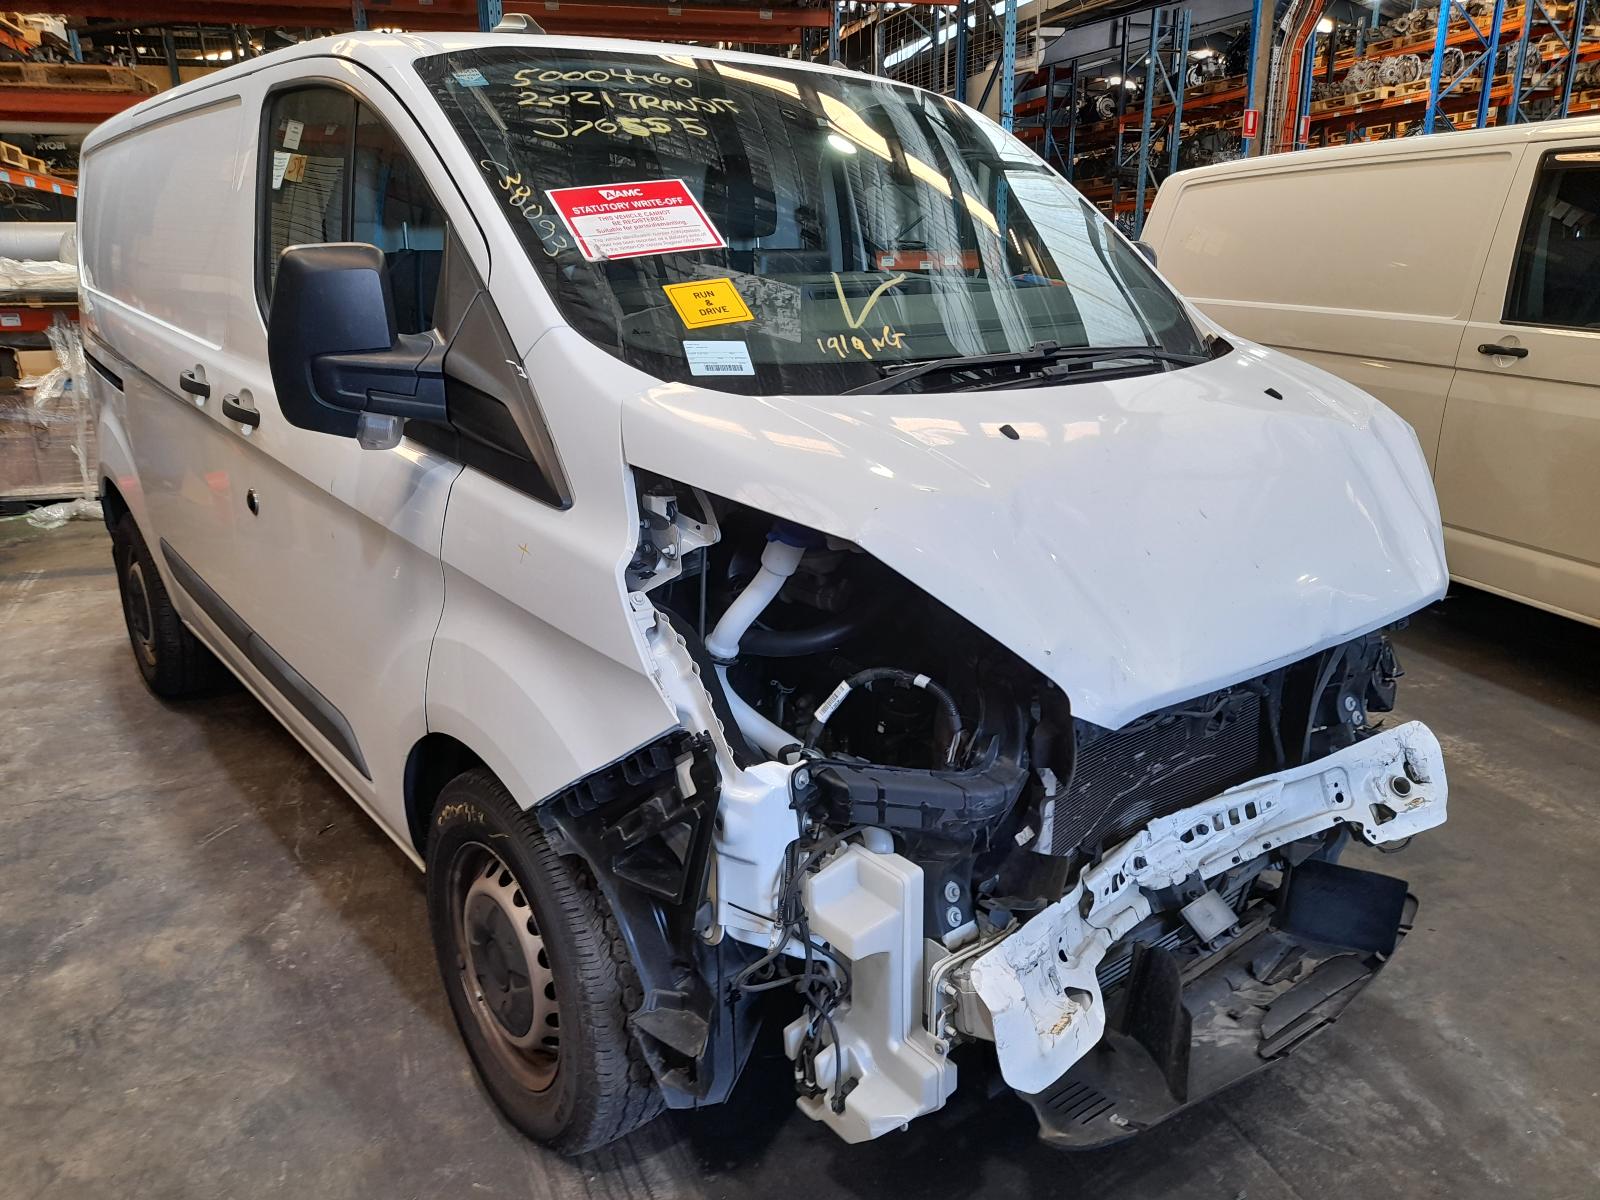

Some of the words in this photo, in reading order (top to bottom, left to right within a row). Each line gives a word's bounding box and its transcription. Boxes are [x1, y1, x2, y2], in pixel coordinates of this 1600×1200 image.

[517, 91, 615, 108] 2021
[619, 92, 740, 114] TRANSIT
[572, 202, 630, 215] STATUTORY
[631, 197, 684, 208] WRITE-OFF
[693, 290, 715, 299] RUN
[699, 306, 729, 316] DRIVE
